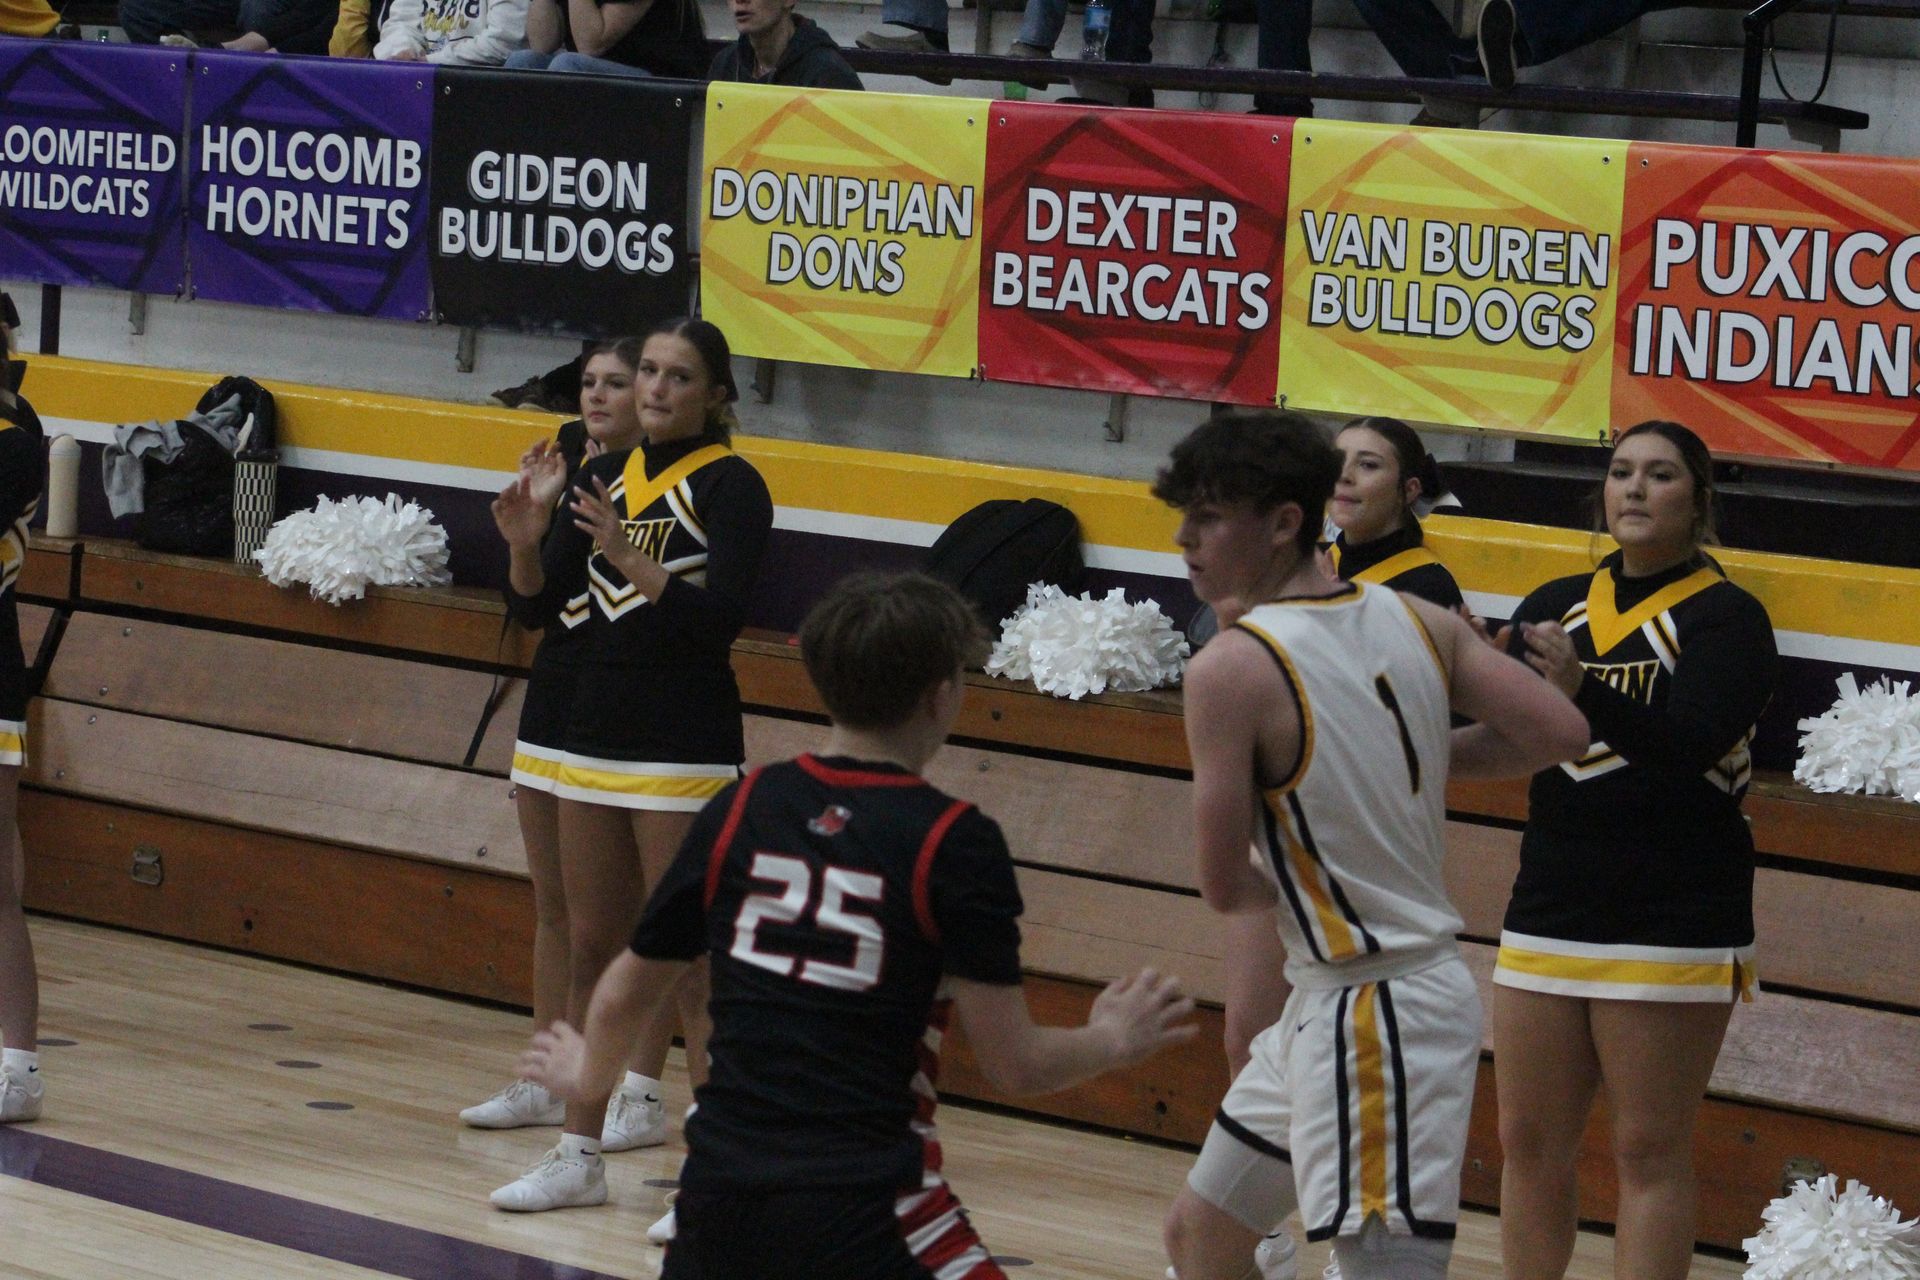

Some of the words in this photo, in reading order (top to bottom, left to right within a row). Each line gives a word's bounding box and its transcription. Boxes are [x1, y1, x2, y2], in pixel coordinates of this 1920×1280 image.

[202, 124, 422, 189] HOLCOMB
[469, 150, 648, 212] GIDEON
[0, 170, 150, 218] WILDCATS
[206, 183, 411, 249] HORNETS
[711, 167, 974, 237] DONIPHAN
[1026, 187, 1239, 258] DEXTER
[439, 206, 674, 273] BULLDOGS
[768, 232, 906, 294] DONS
[1302, 210, 1408, 270] VAN
[1422, 220, 1610, 288] BUREN
[992, 251, 1272, 331] BEARCATS
[1309, 273, 1596, 351] BULLDOGS
[1632, 303, 1920, 398] INDIAN
[1374, 671, 1421, 795] 1
[729, 852, 885, 992] 25
